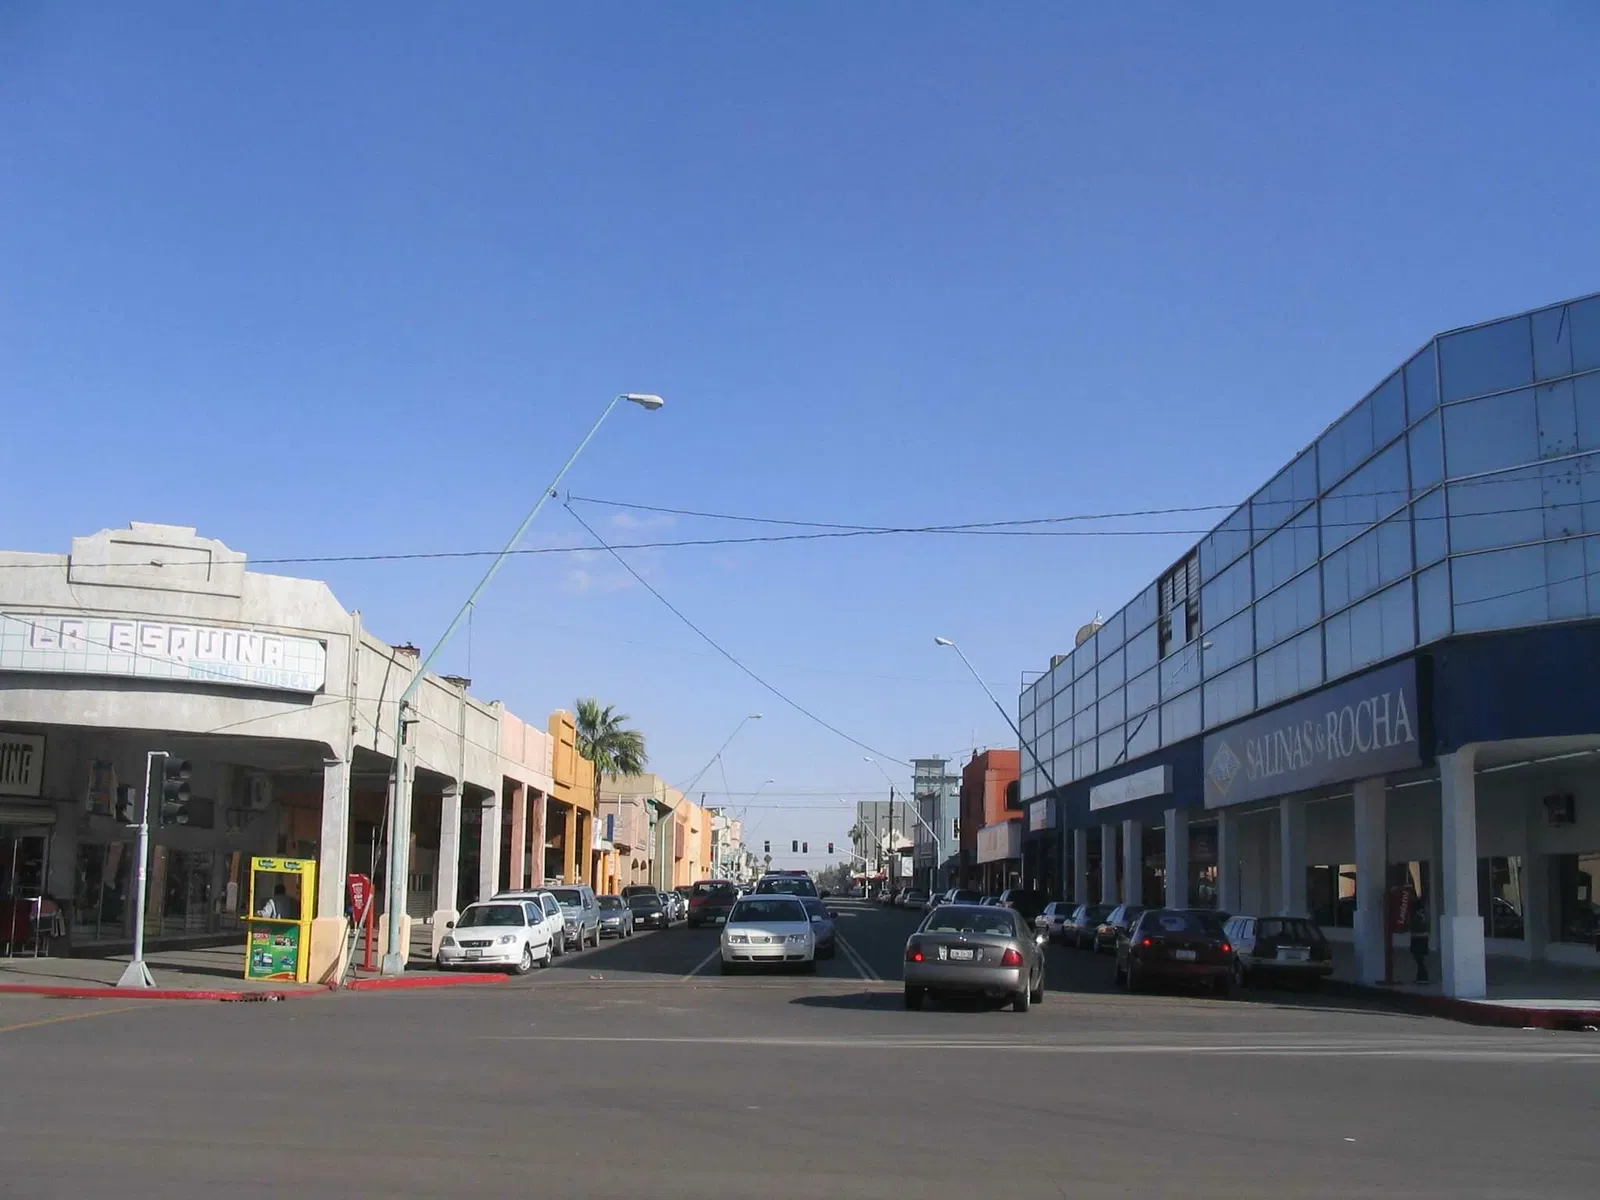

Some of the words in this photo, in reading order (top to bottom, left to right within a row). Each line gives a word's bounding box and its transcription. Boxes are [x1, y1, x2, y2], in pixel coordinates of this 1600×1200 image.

[30, 620, 85, 650] LA
[109, 621, 284, 664] ESQUINA
[1246, 720, 1314, 781] SALINAS
[1315, 723, 1326, 752] &
[1325, 687, 1416, 760] ROCHA
[0, 743, 34, 785] INA
